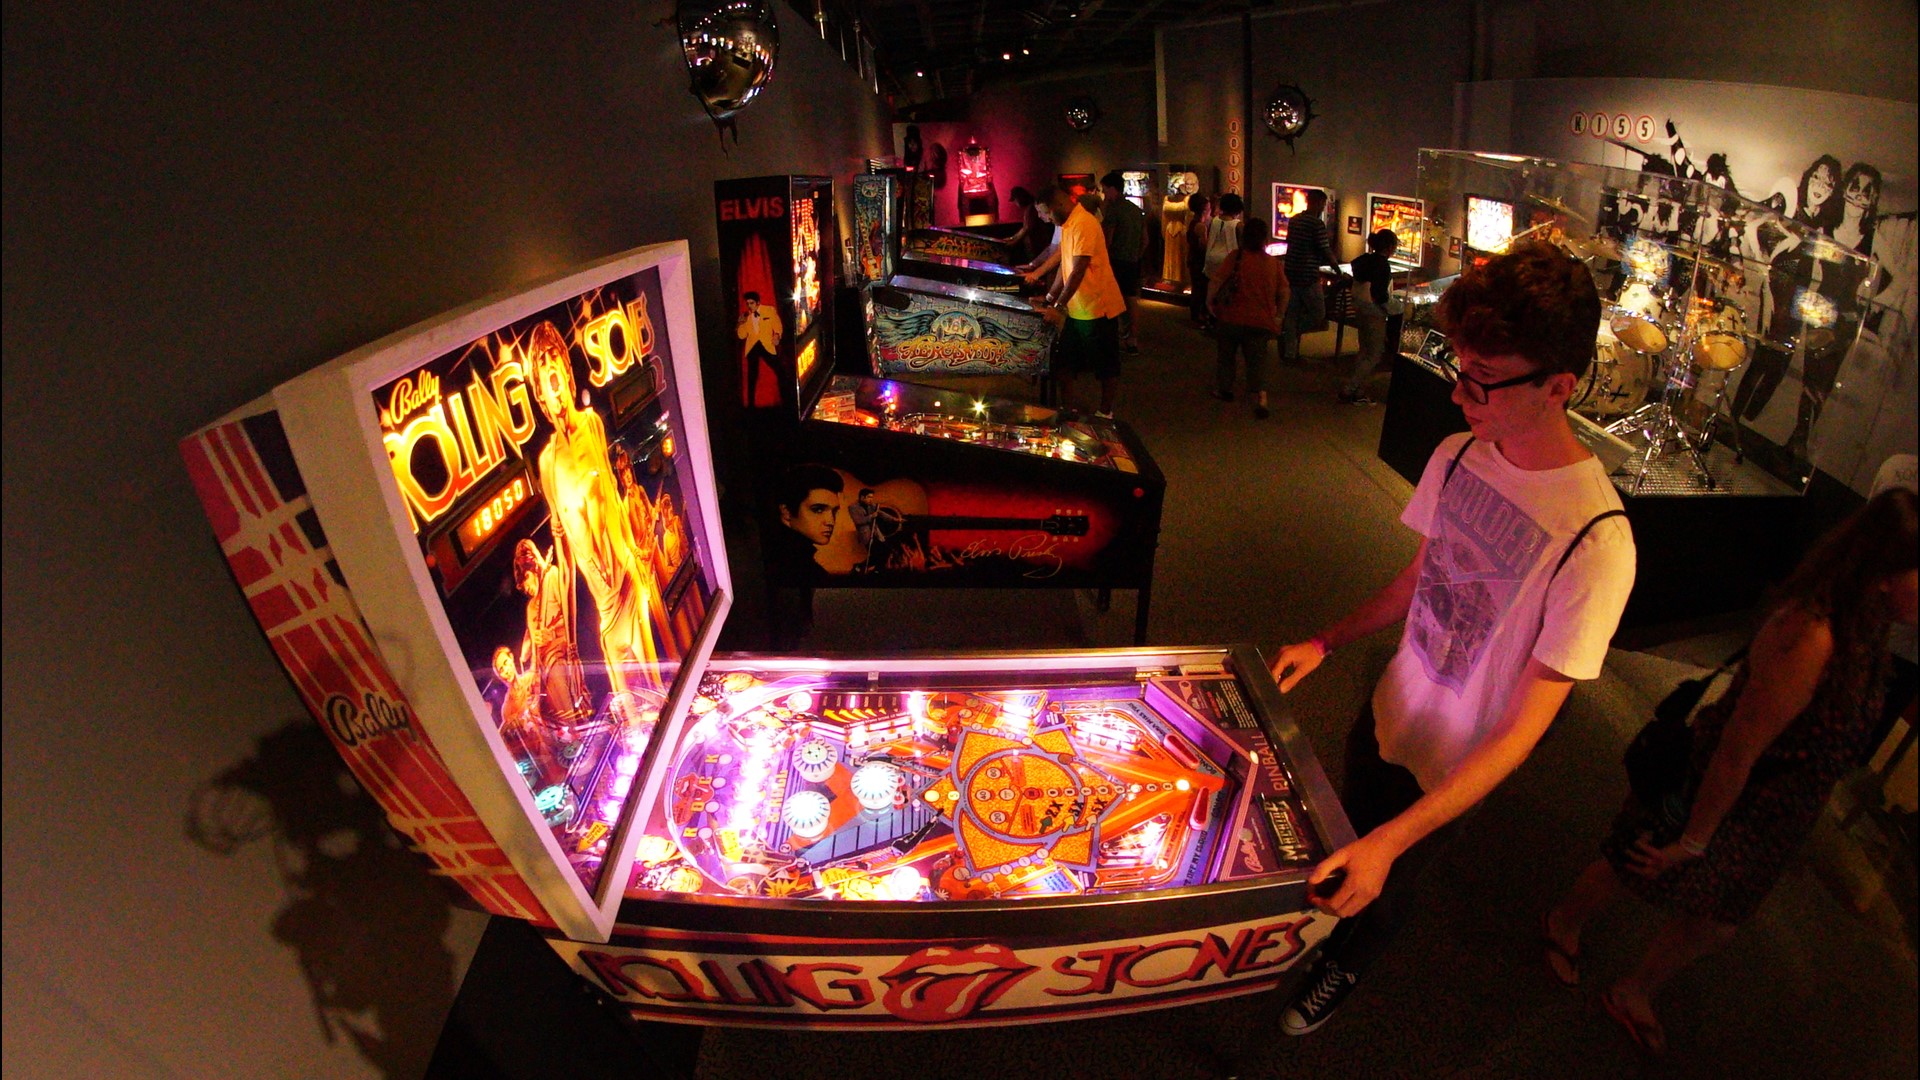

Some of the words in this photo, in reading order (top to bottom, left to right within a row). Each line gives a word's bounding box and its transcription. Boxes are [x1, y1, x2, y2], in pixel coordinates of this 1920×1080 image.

[1573, 114, 1651, 140] KISS
[720, 196, 784, 221] ELVIS
[589, 291, 655, 387] STONES
[898, 335, 1012, 369] AEROSMITH
[390, 369, 442, 425] Bally
[474, 479, 524, 537] 18050
[960, 538, 1001, 559] Elvis
[1008, 533, 1063, 579] Presley
[326, 692, 418, 746] Bally
[1251, 731, 1290, 791] PINBALL
[1045, 800, 1063, 818] 2X
[1069, 799, 1084, 816] 3X
[1091, 797, 1108, 815] 5X
[578, 950, 876, 1012] ROLLING
[1042, 915, 1316, 997] STONES
